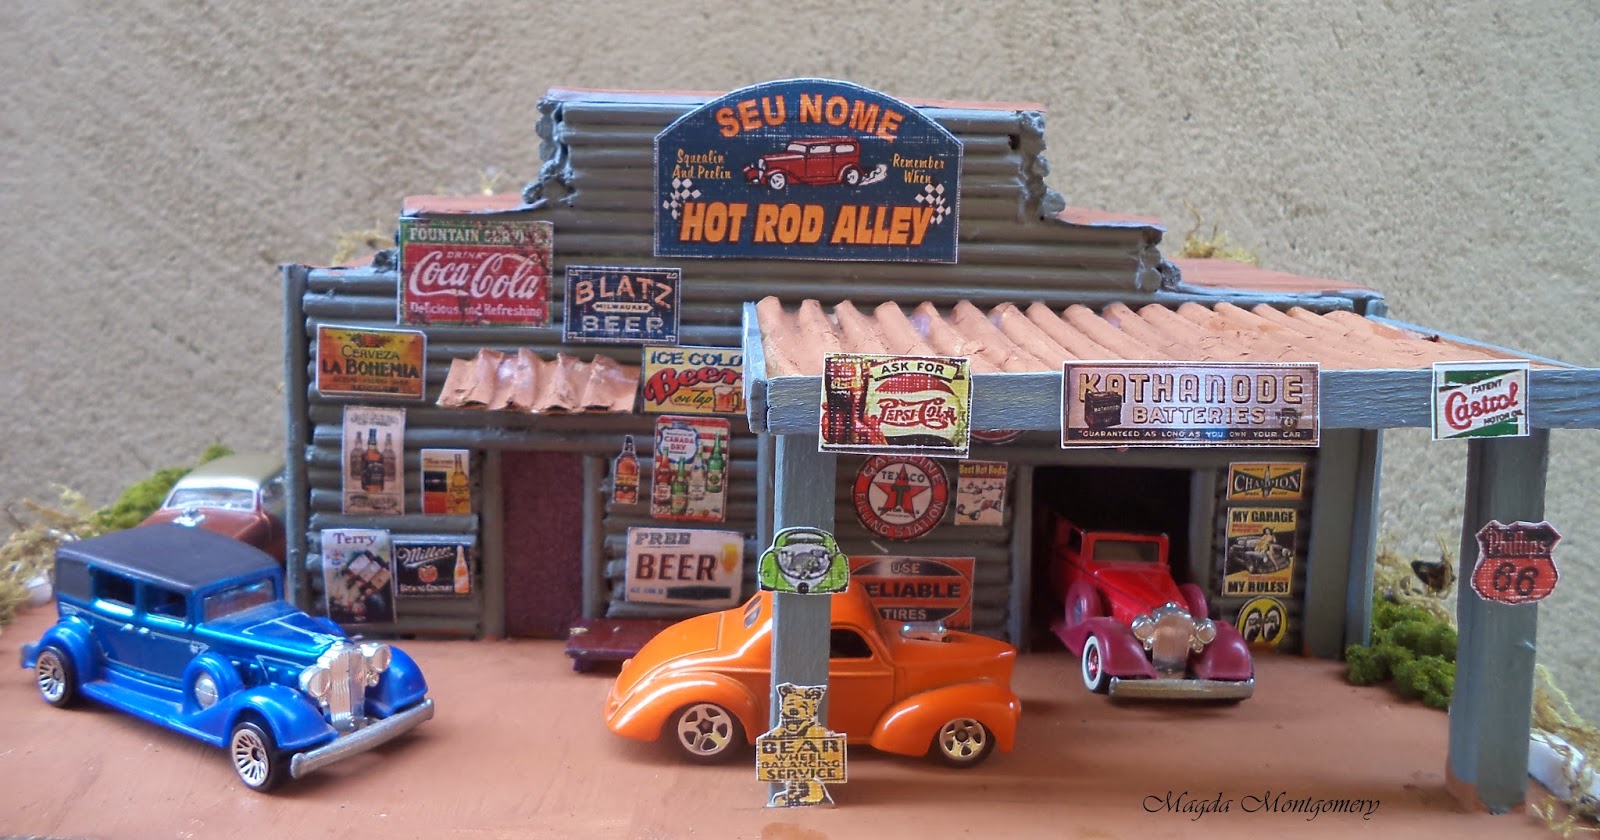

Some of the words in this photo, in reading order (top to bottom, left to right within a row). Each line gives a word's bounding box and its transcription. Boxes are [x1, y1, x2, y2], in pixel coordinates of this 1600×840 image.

[715, 94, 787, 138] SEU
[800, 93, 906, 144] NOME
[892, 153, 945, 171] Remember
[672, 164, 694, 179] And
[697, 165, 732, 179] Peelin
[903, 169, 932, 184] When
[680, 201, 748, 244] HOT
[753, 202, 824, 245] ROD
[829, 204, 936, 246] ALLEY
[409, 227, 479, 242] FOUNTAIN
[446, 251, 485, 259] DRINK
[575, 275, 674, 309] BLATZ
[410, 301, 460, 315] Delicious
[484, 303, 543, 317] Refreshing
[596, 303, 649, 311] MILWAUKEE
[582, 316, 664, 333] BEER
[341, 344, 400, 360] CERVEZA
[651, 351, 684, 365] ICE
[322, 358, 343, 375] LA
[345, 359, 420, 379] BOHEMIA
[881, 362, 909, 375] ASK
[917, 362, 945, 374] FOR
[644, 366, 743, 405] Beer
[1078, 374, 1304, 404] KATHANODE
[1471, 379, 1503, 394] PATENT
[674, 394, 691, 403] on
[1445, 381, 1518, 431] Castrol
[1132, 406, 1266, 424] BATTERIES
[1483, 412, 1510, 425] MOTOR
[1511, 409, 1524, 419] OIL
[664, 435, 694, 444] CANADA
[1144, 430, 1157, 438] AS
[1162, 430, 1186, 438] LONG
[1187, 430, 1201, 438] AS
[1206, 430, 1224, 438] YOU
[1230, 430, 1247, 438] OWN
[1253, 430, 1277, 438] YOUR
[855, 492, 889, 535] FILLING
[894, 500, 943, 537] STATION
[1232, 510, 1249, 523] MY
[1251, 510, 1294, 523] GARAGE
[333, 532, 377, 546] Terry
[635, 532, 692, 545] FREE
[398, 546, 455, 567] Miller
[636, 553, 717, 581] BEER
[891, 563, 921, 574] USE
[1492, 562, 1539, 596] 66
[864, 582, 961, 598] ELIABLE
[1228, 581, 1247, 593] MY
[1248, 581, 1289, 593] RULES!
[883, 609, 926, 620] TIRES
[762, 740, 839, 754] BEAR
[761, 760, 840, 769] BALANCING
[775, 753, 824, 761] WHEEL
[767, 768, 836, 779] SERVICE
